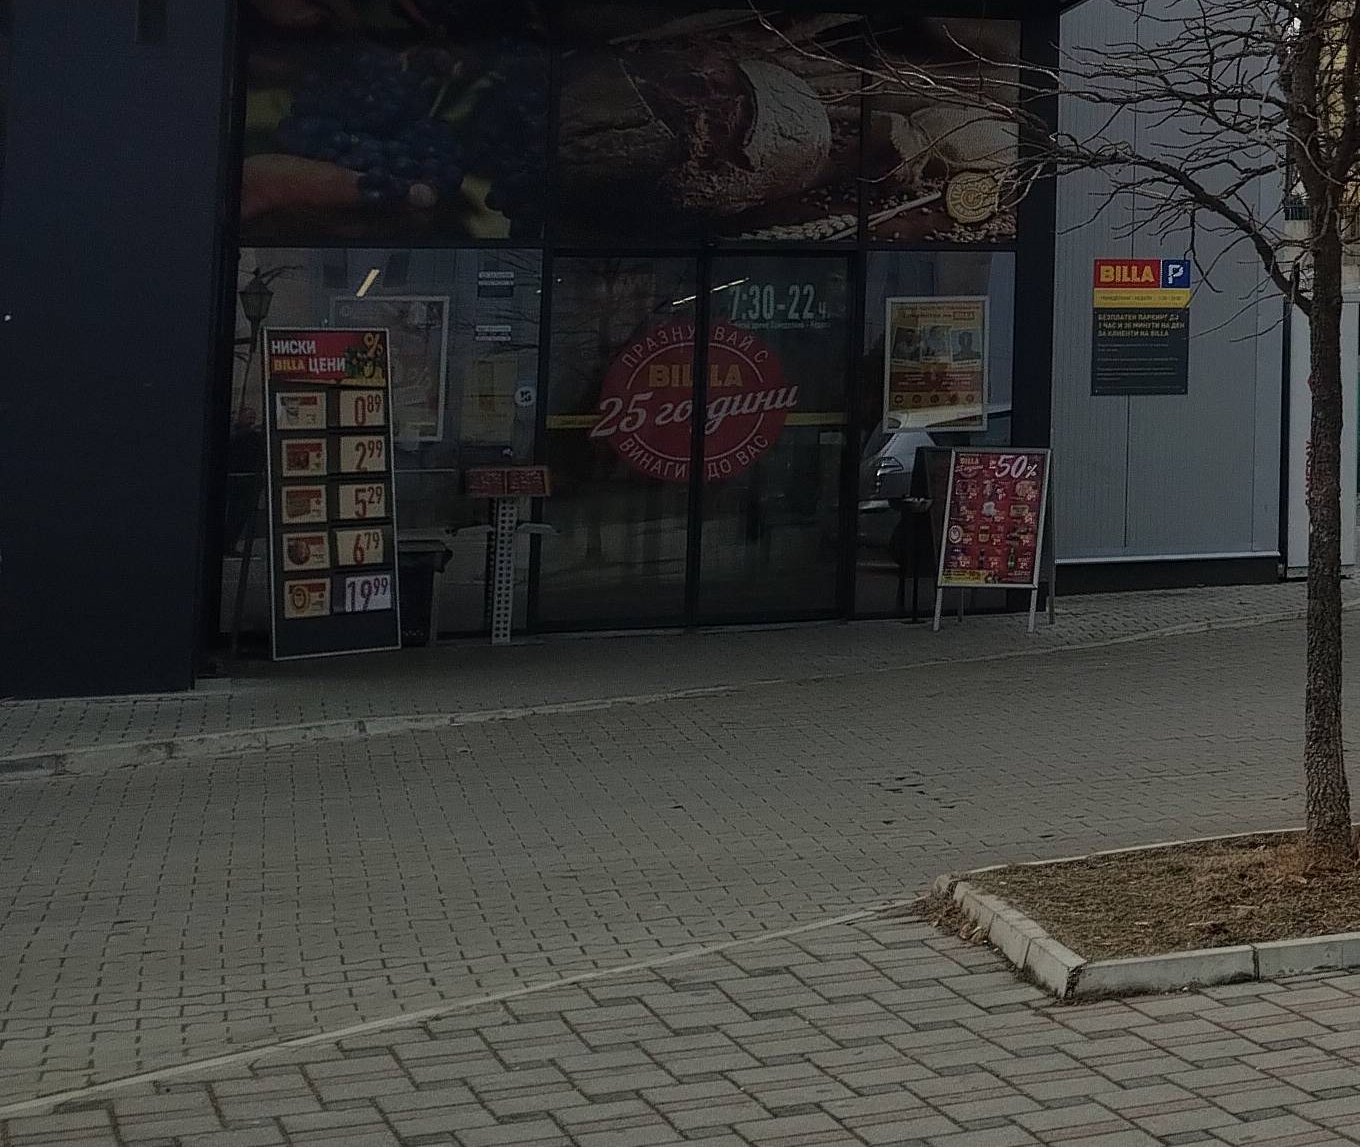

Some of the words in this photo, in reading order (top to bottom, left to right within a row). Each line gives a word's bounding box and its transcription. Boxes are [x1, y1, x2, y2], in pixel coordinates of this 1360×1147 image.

[1099, 264, 1155, 283] BILLA
[271, 340, 317, 355] НИСКИ
[308, 357, 346, 375] ЦЕНИ
[588, 391, 654, 438] 25
[619, 438, 687, 479] ВИНАГИ
[736, 434, 769, 467] ВАС
